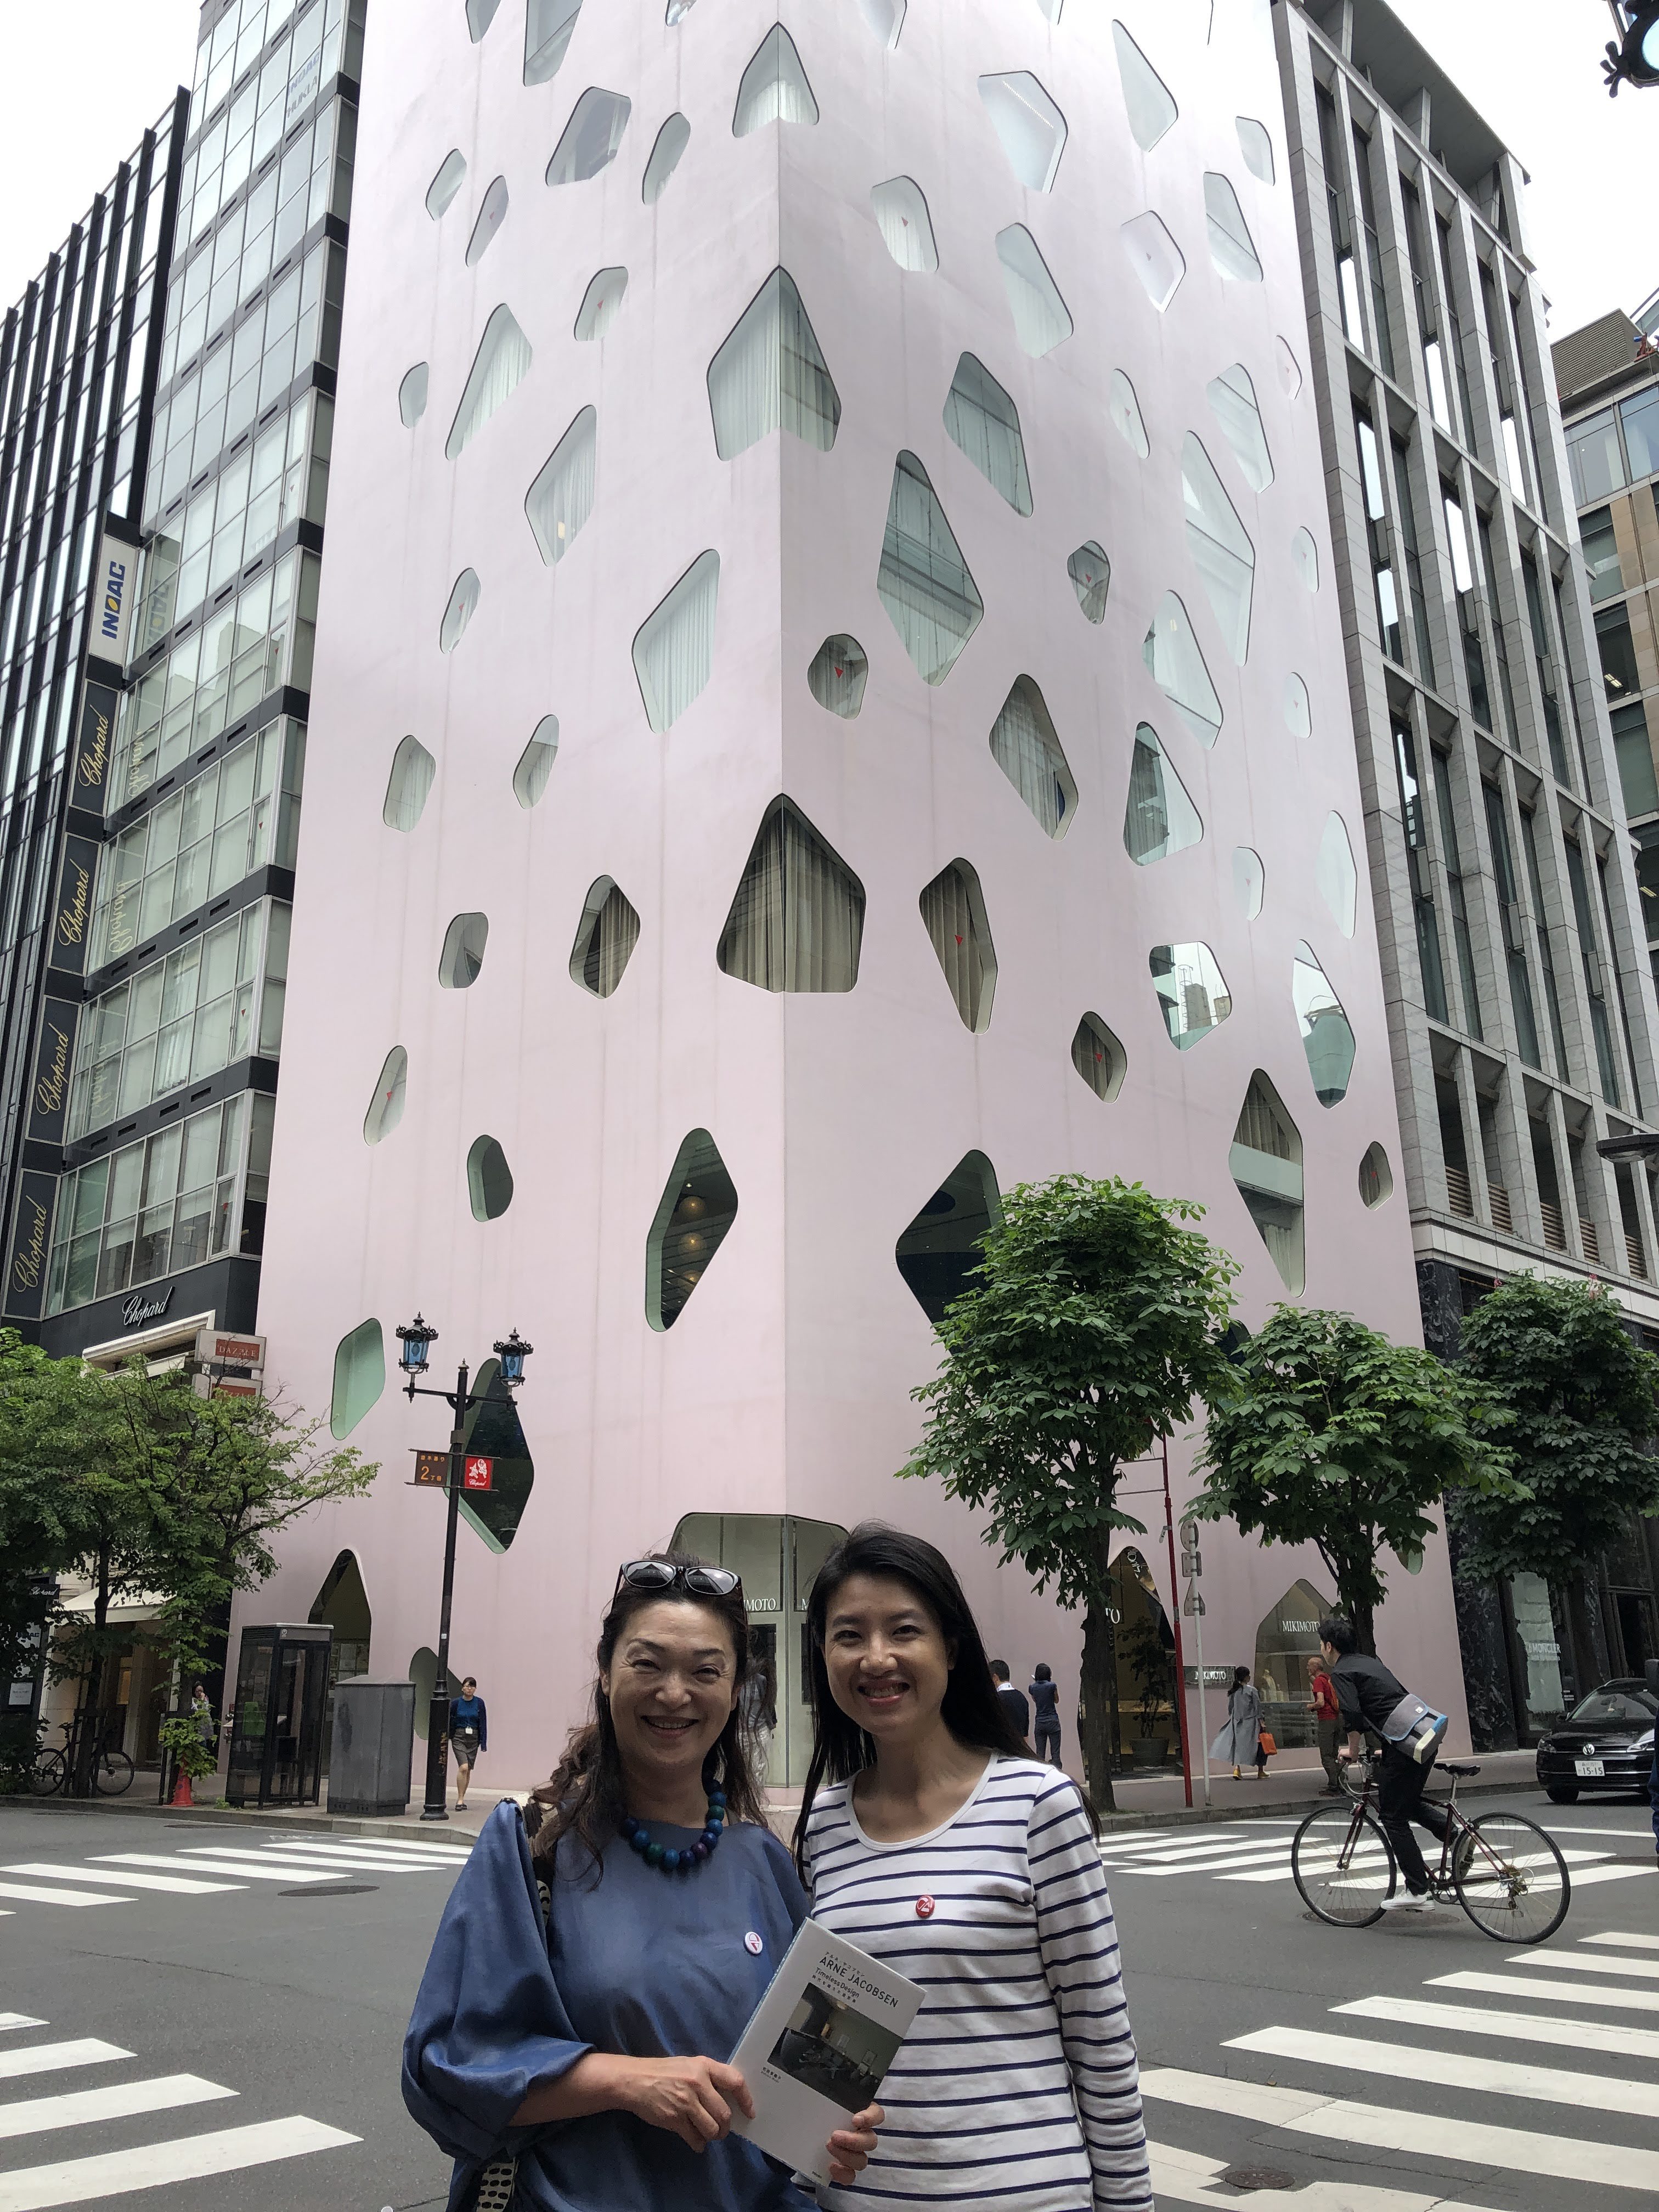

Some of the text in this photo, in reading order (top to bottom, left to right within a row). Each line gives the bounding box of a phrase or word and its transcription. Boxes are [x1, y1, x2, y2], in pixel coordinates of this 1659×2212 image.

[101, 561, 126, 640] INOAC
[78, 704, 109, 786] Chopard
[58, 859, 89, 946] Chopard
[36, 1022, 69, 1115] Chopard
[13, 1195, 47, 1293] Chopard
[122, 1286, 174, 1327] Chopard
[1194, 1671, 1226, 1680] MKIMOTO
[1583, 1767, 1603, 1775] 15-15
[819, 1956, 899, 2008] ARNE JACOBSEN
